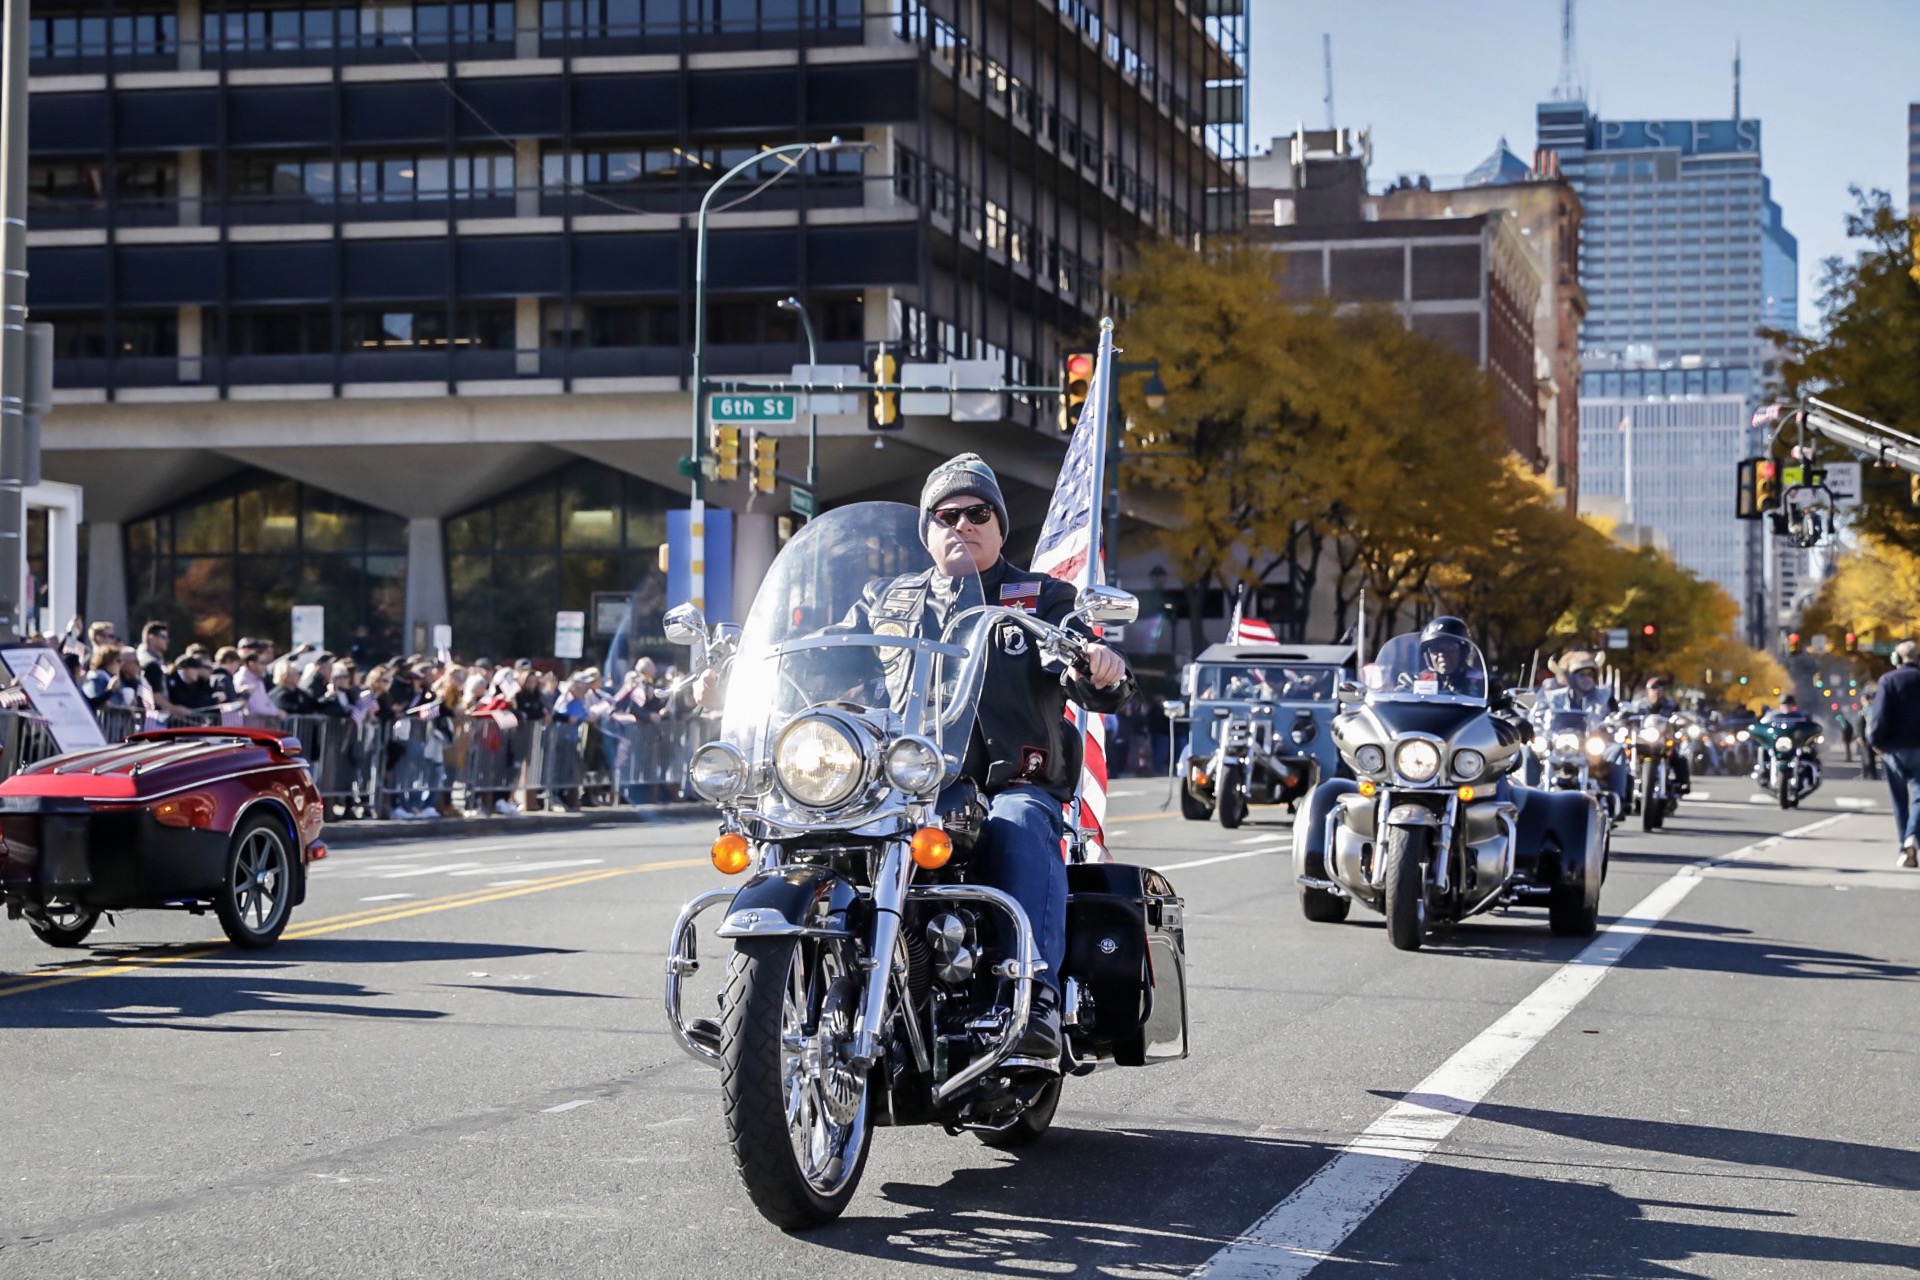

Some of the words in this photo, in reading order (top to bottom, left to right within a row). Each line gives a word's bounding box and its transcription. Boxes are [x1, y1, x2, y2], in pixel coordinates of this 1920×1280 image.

[1601, 120, 1758, 153] PSFS
[720, 399, 755, 416] 6th
[763, 399, 785, 416] St
